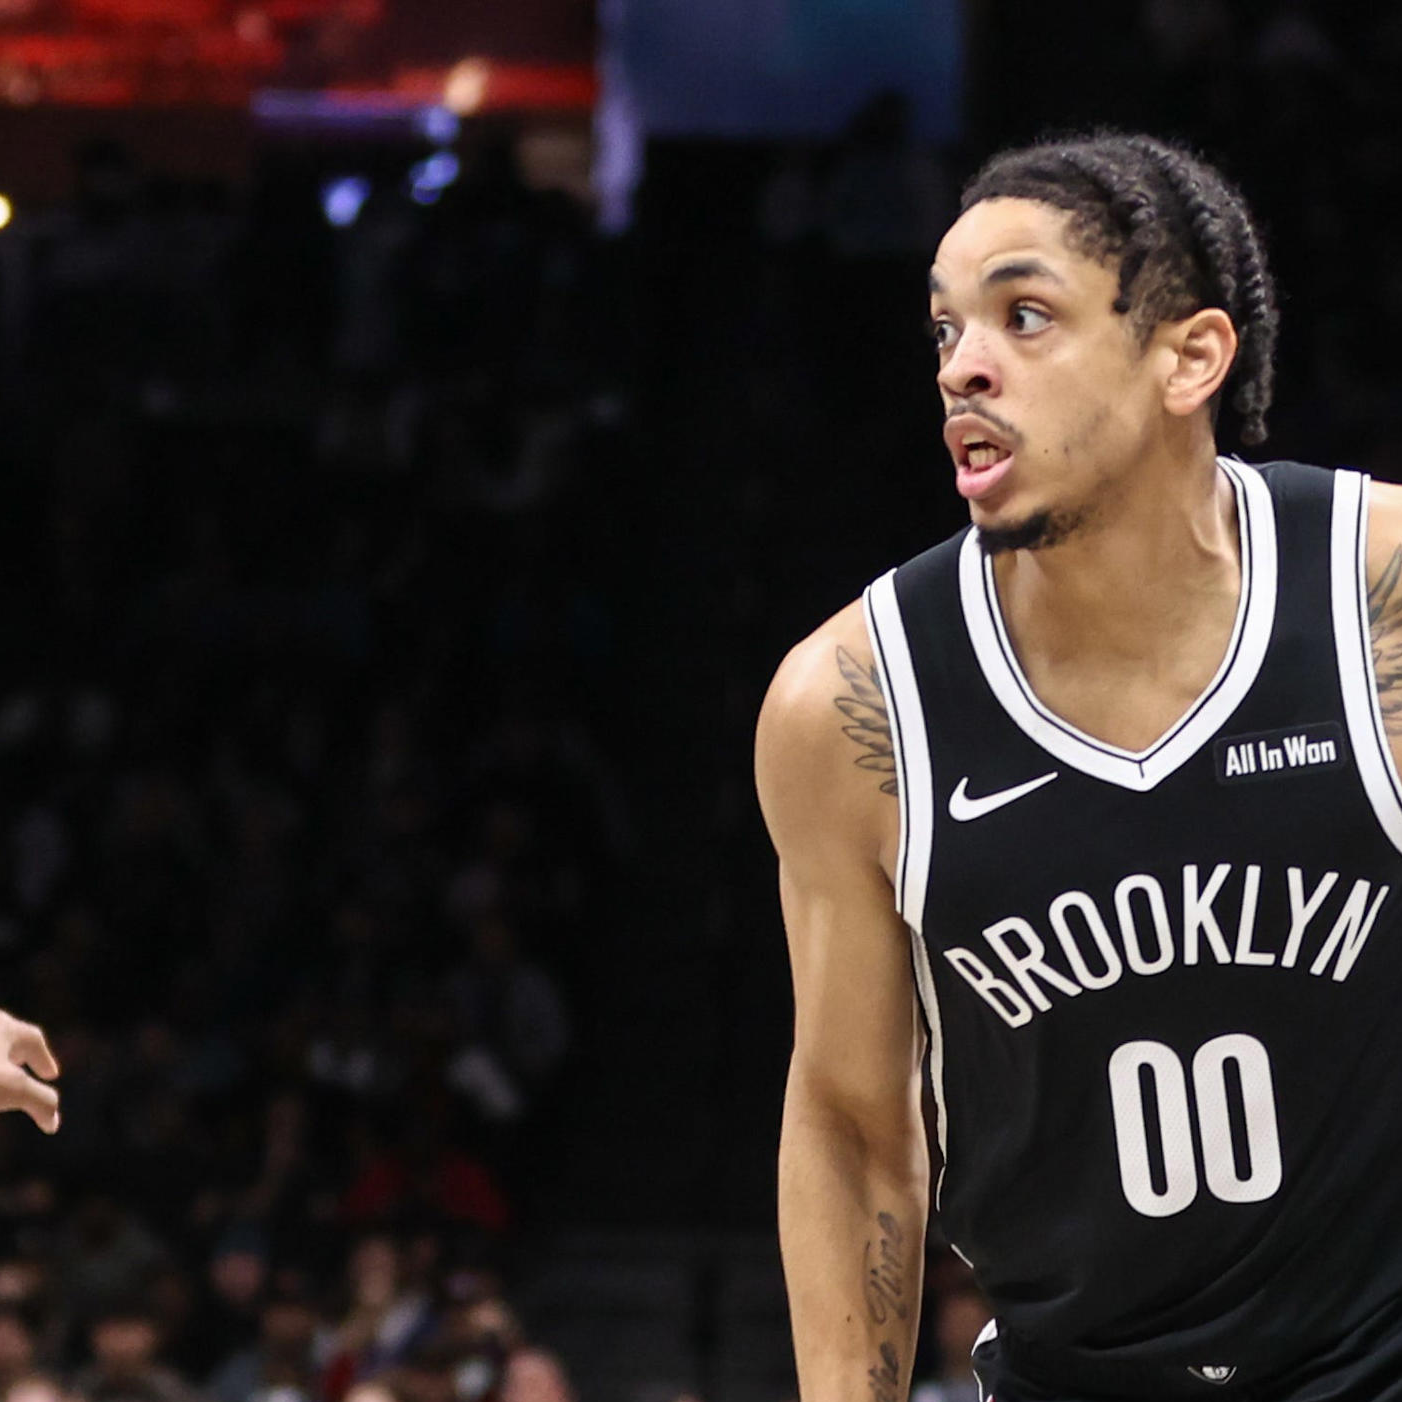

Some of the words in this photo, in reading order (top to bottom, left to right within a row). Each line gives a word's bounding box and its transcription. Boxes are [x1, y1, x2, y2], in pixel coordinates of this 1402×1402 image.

[1226, 744, 1257, 777] All
[1259, 740, 1284, 772] In
[1283, 734, 1337, 767] Won
[943, 863, 1390, 1029] BROOKLYN
[1108, 1033, 1283, 1218] 00
